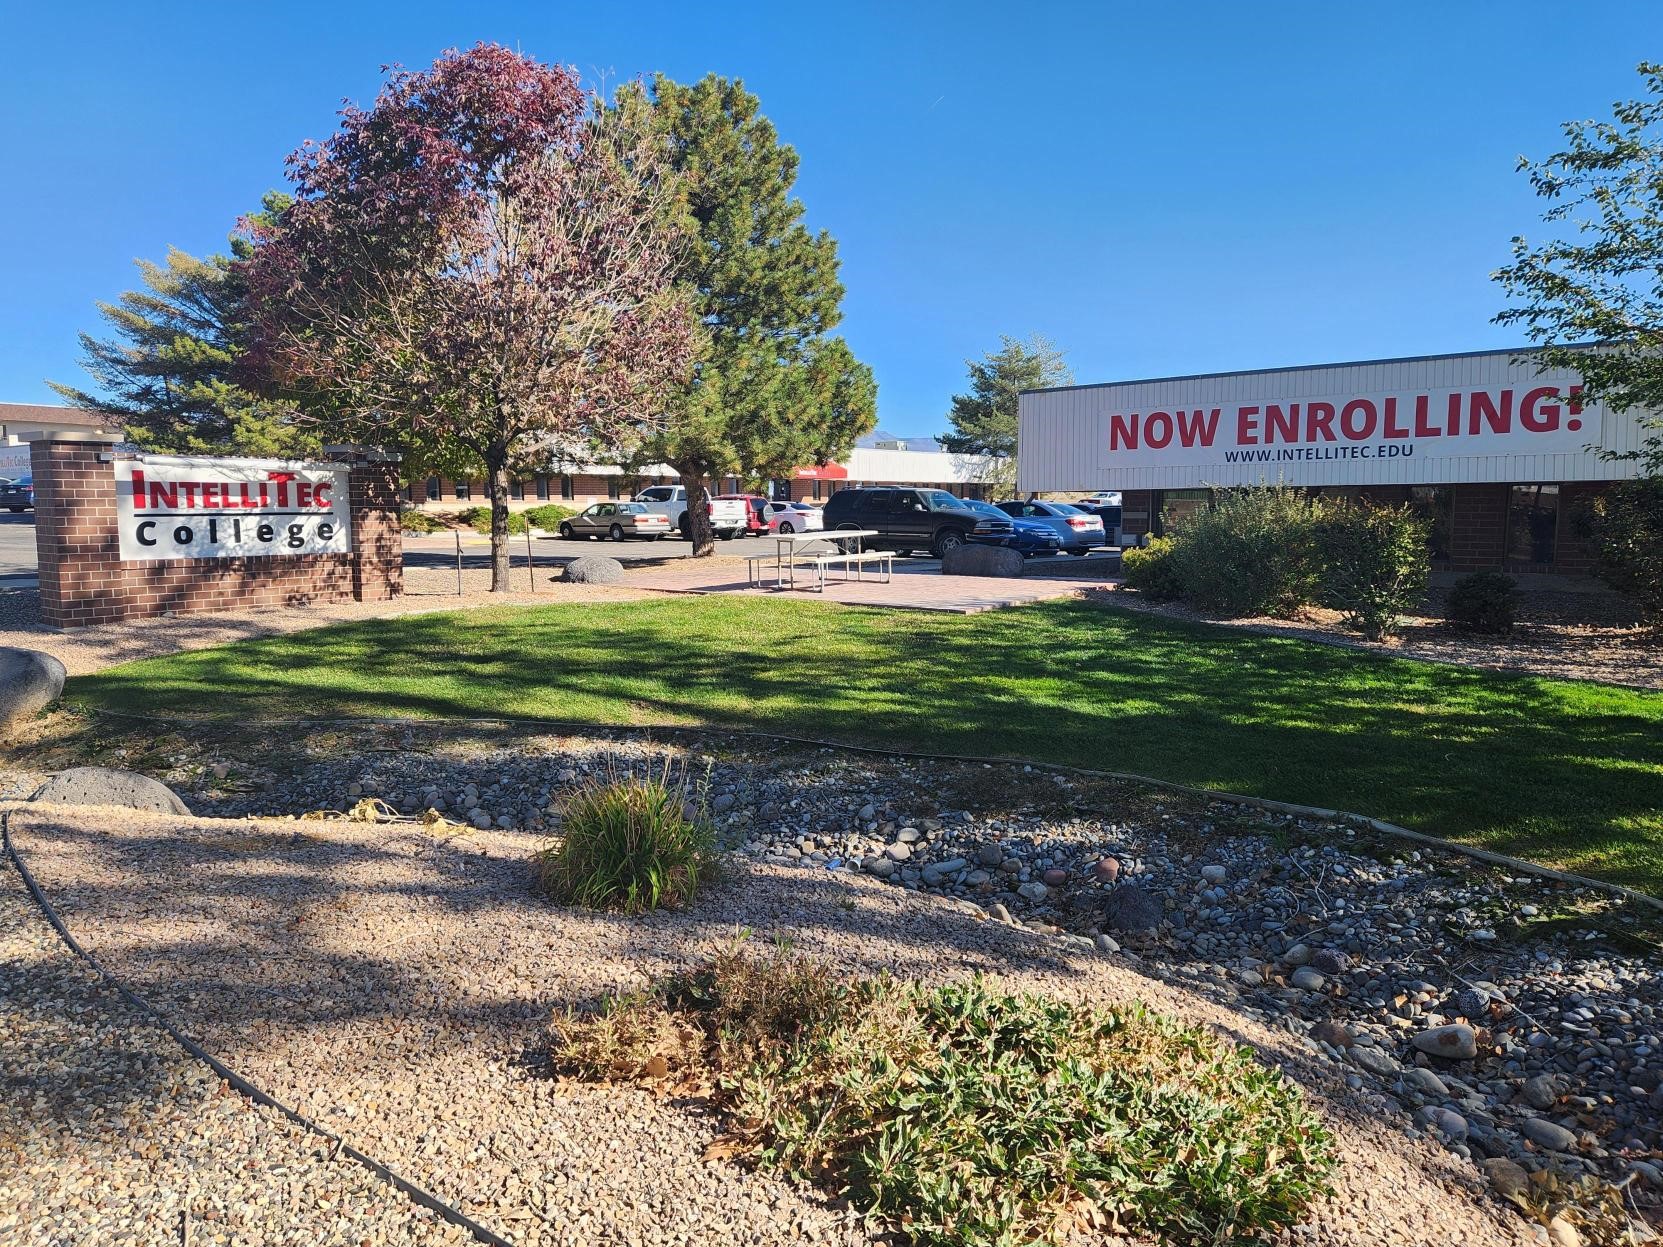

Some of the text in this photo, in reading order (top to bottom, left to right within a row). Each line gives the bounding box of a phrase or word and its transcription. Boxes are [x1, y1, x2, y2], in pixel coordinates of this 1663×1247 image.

[1110, 385, 1585, 451] NOW ENROLLING!
[1224, 444, 1414, 463] WWW.INTELLITEC.EDU
[135, 518, 334, 549] College
